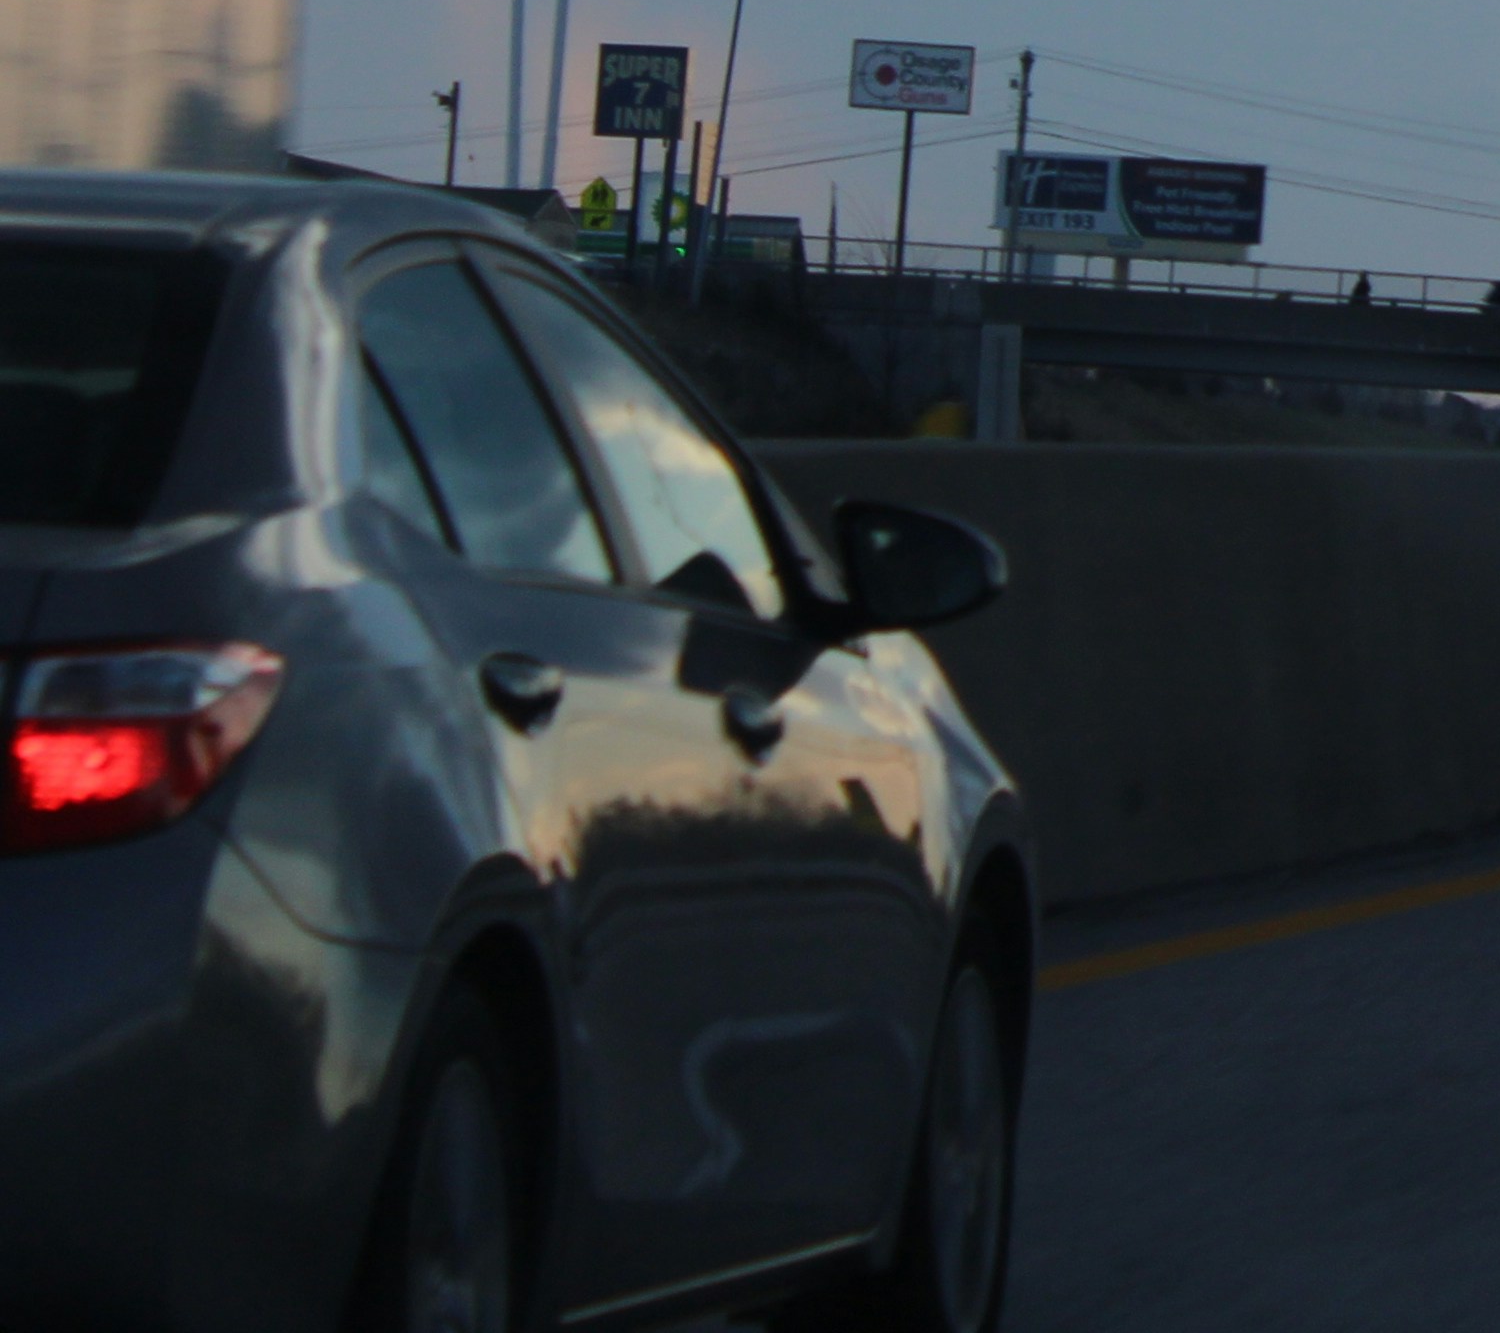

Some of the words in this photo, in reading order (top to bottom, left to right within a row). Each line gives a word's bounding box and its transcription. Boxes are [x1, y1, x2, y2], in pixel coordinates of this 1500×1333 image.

[604, 53, 680, 89] SUPER
[901, 68, 967, 91] County
[633, 82, 650, 104] 7
[614, 106, 664, 130] INN
